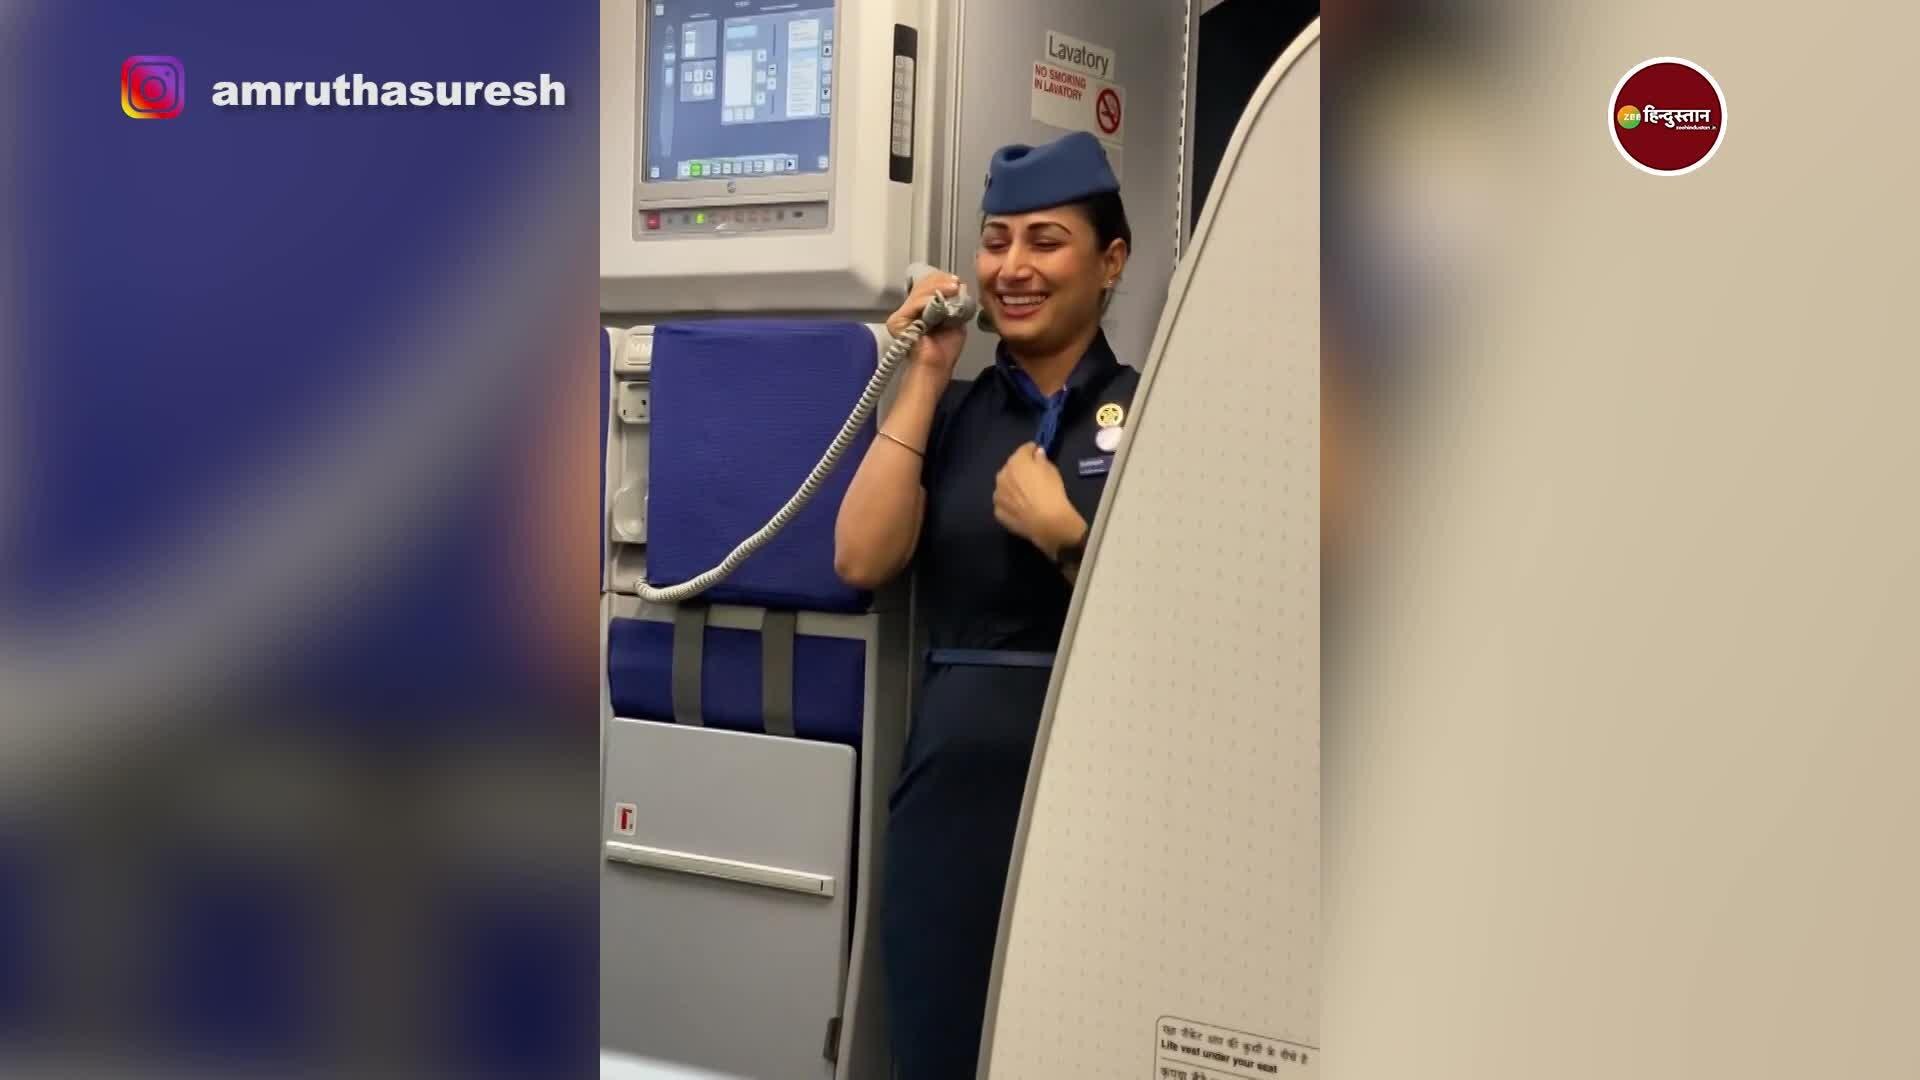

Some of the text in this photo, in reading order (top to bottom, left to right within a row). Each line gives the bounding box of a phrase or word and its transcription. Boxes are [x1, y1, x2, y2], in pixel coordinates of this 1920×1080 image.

[1048, 35, 1109, 76] Lavatory
[1034, 78, 1083, 101] IN LAVATORY
[1035, 64, 1087, 89] NO SMOKING
[1160, 1039, 1278, 1074] Life vest under your seat
